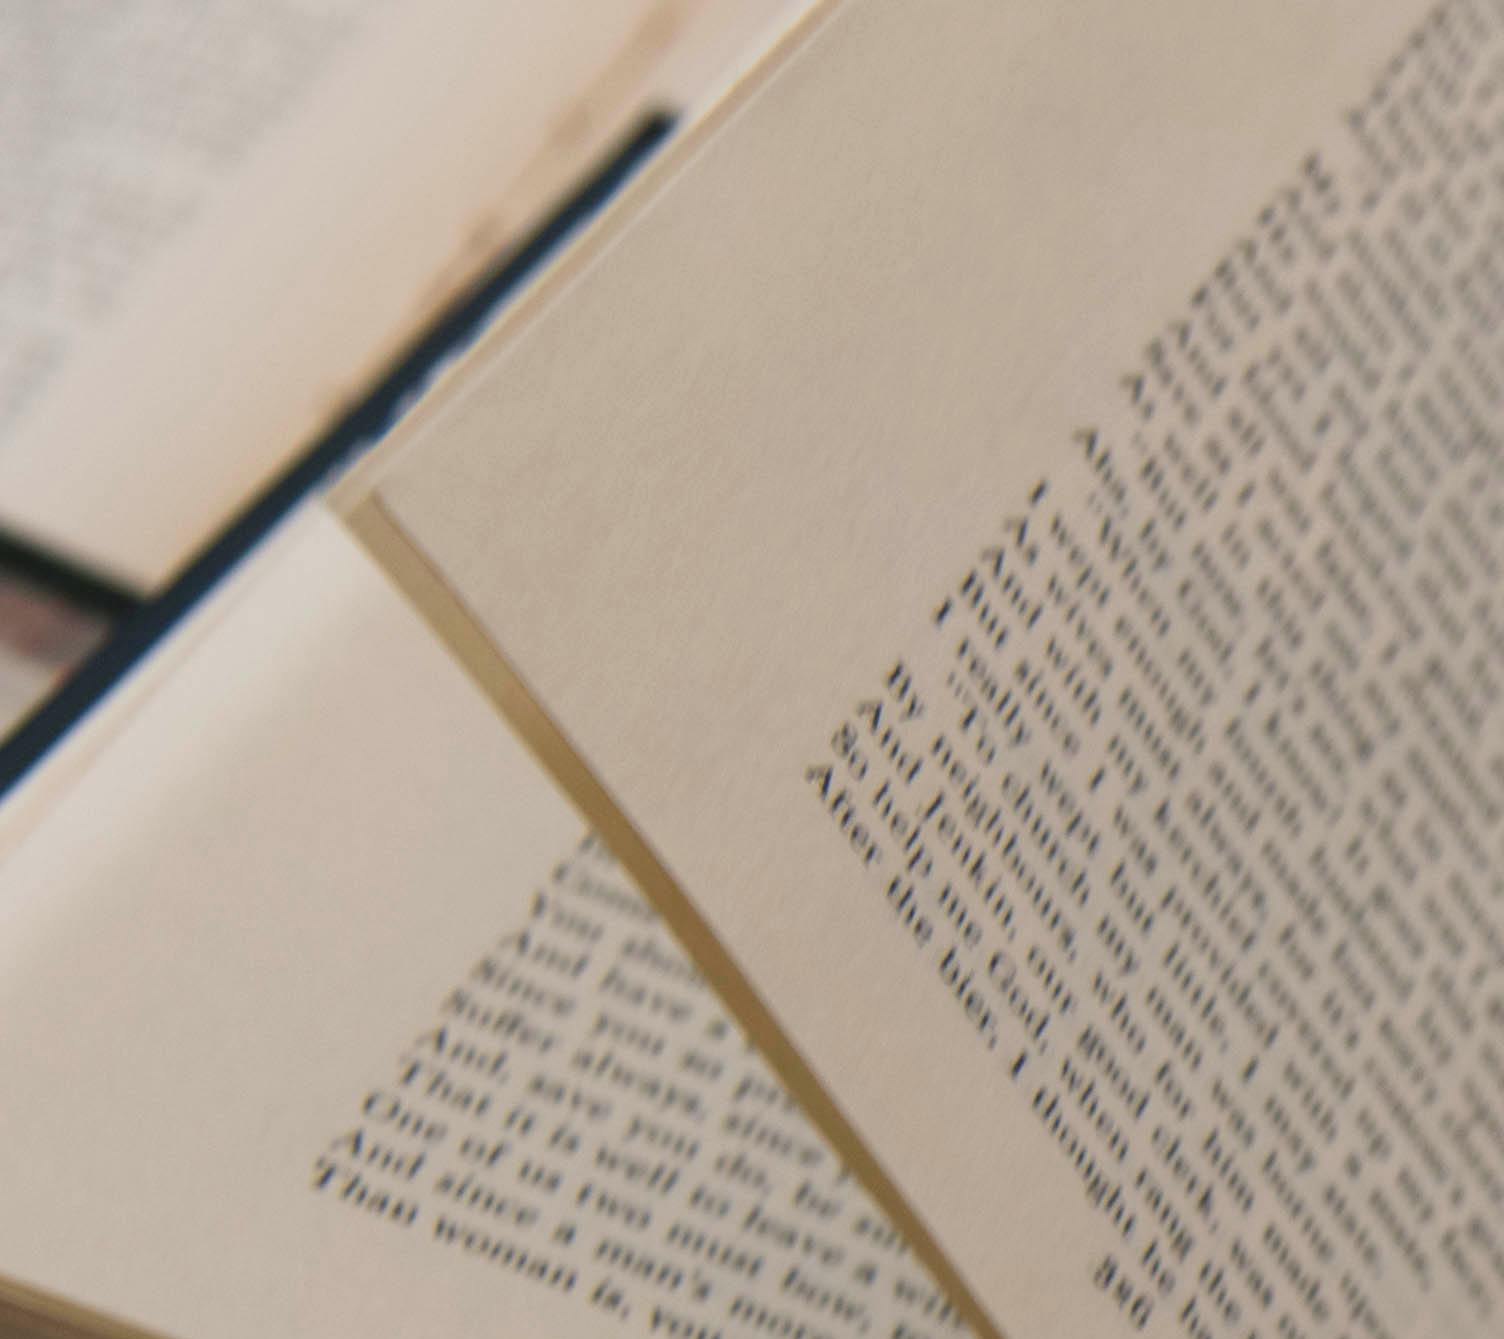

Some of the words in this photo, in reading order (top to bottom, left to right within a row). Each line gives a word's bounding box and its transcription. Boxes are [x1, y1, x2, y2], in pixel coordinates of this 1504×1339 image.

[312, 1152, 421, 1228] Than
[432, 1215, 579, 1294] woman
[803, 763, 880, 868] After
[884, 873, 935, 946] the
[936, 944, 999, 1052] bier,
[1007, 1048, 1031, 1082] I
[1029, 1084, 1138, 1240] thought
[1138, 1237, 1177, 1296] he
[829, 720, 871, 783] So
[870, 777, 935, 880] help
[935, 881, 984, 946] me
[985, 949, 1053, 1056] God,
[1058, 1055, 1131, 1165] when
[1132, 1166, 1196, 1265] rang
[1196, 1259, 1242, 1324] the
